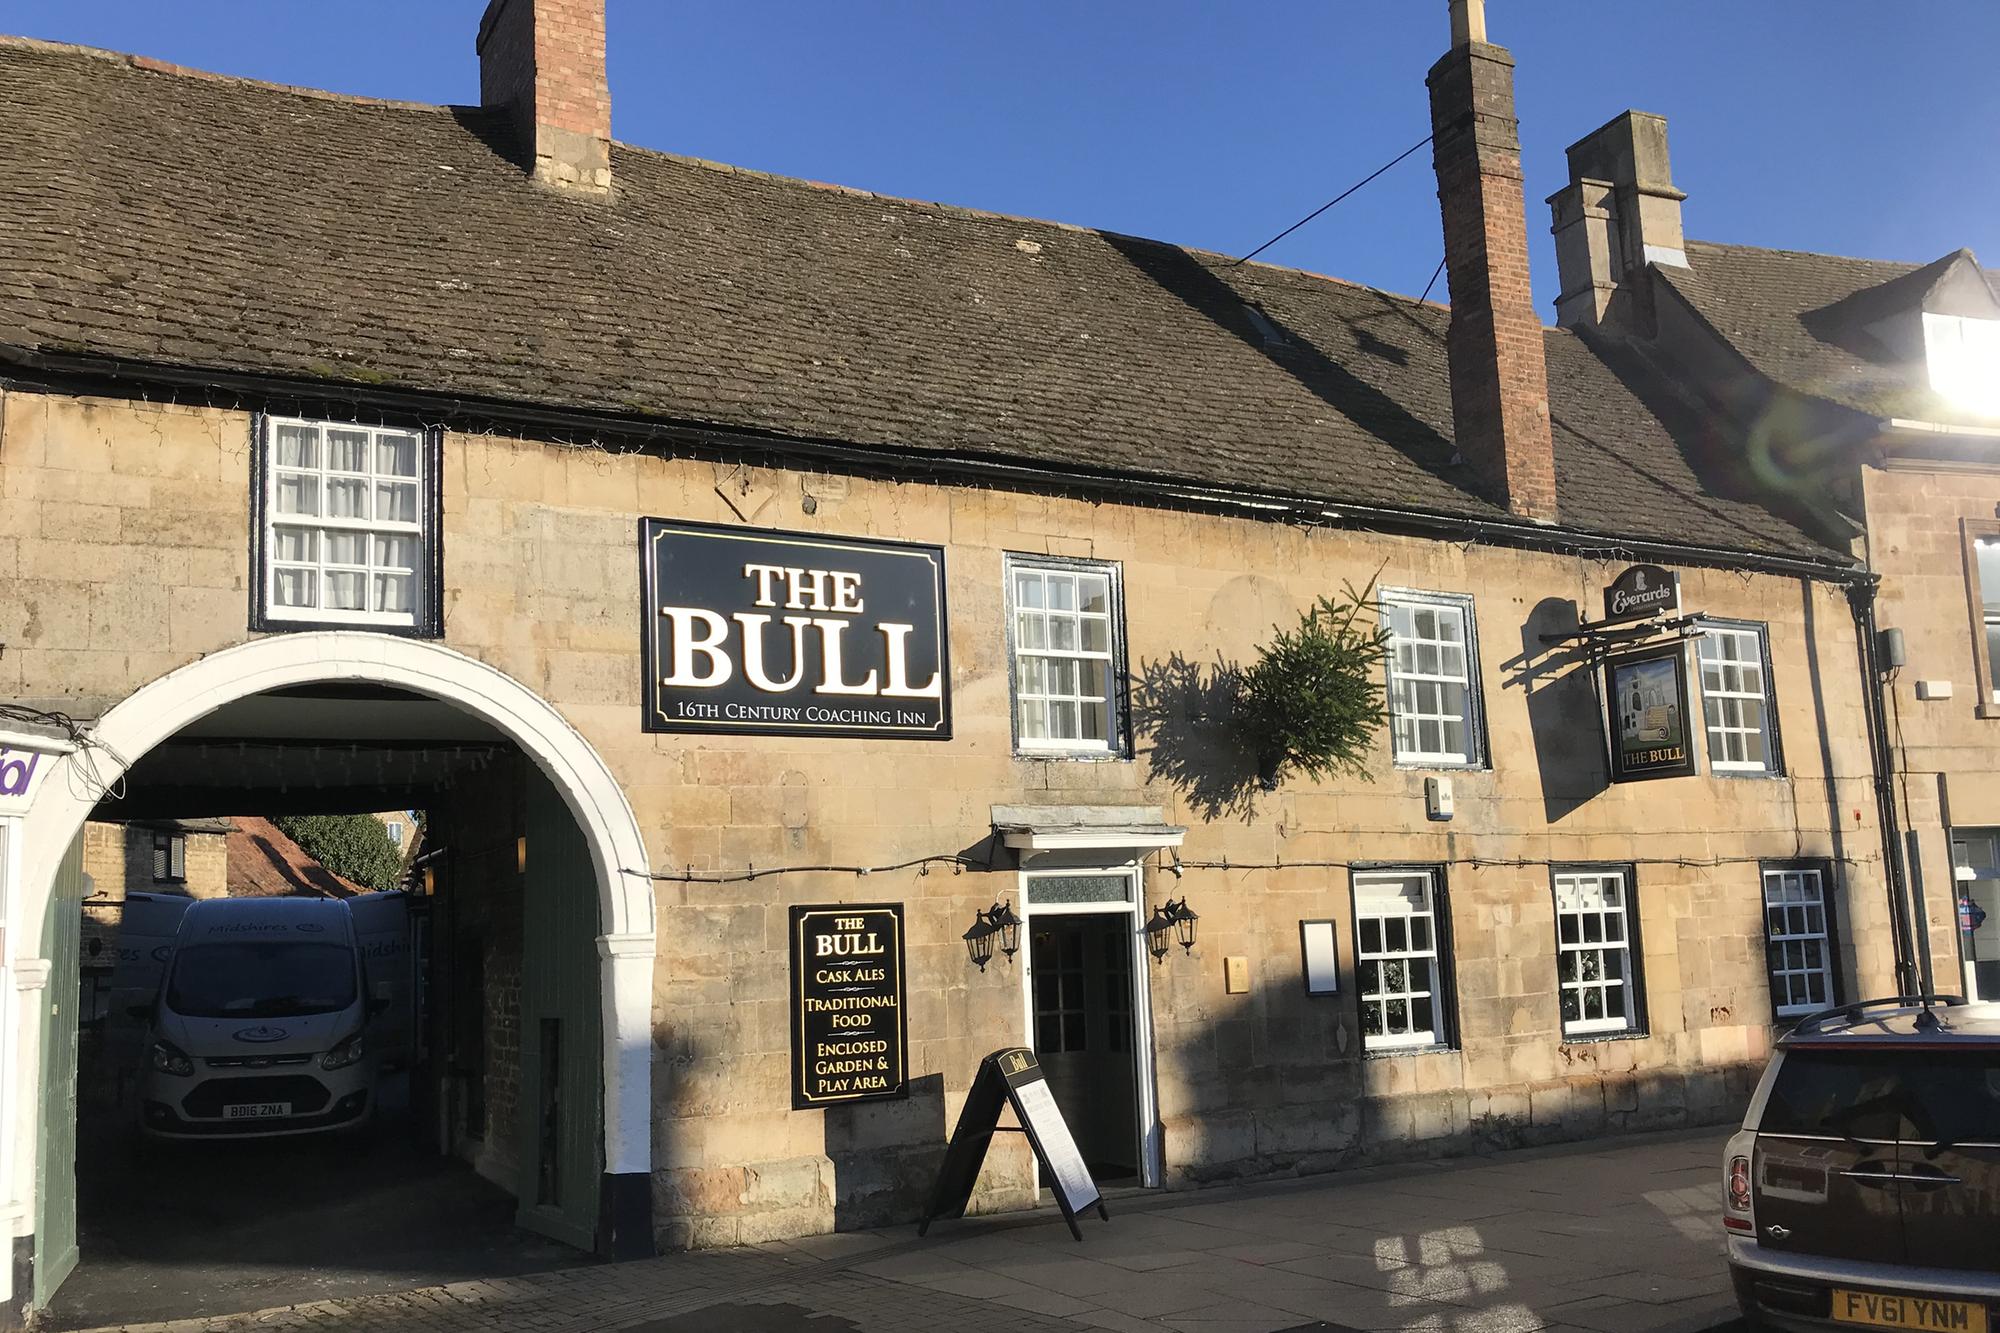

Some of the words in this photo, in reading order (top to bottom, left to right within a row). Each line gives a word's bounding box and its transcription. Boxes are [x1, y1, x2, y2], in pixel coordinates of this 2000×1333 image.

[744, 563, 864, 613] THE
[1612, 584, 1671, 614] Everards
[661, 606, 940, 698] BULL
[677, 701, 719, 719] 16TH
[725, 703, 802, 721] CENTURY
[806, 706, 891, 725] COACHING
[897, 709, 926, 725] INN
[1623, 749, 1648, 766] THE
[1650, 746, 1685, 762] BULL
[208, 922, 288, 934] Midshires
[834, 917, 865, 931] THE
[816, 933, 885, 957] BULL
[816, 970, 852, 984] CASK
[854, 968, 885, 982] ALES
[805, 995, 897, 1012] TRADITIONAL
[832, 1014, 871, 1028] FOOD
[817, 1040, 887, 1056] ENCLOSED
[815, 1059, 873, 1075] GARDEN
[876, 1056, 889, 1070] &
[1009, 1051, 1028, 1071] Bull
[818, 1078, 850, 1093] PLAY
[852, 1076, 887, 1090] AREA
[231, 1106, 257, 1117] BD16
[261, 1105, 284, 1116] ZNA
[1847, 1294, 1905, 1323] FV61
[1913, 1296, 1968, 1329] YNM
